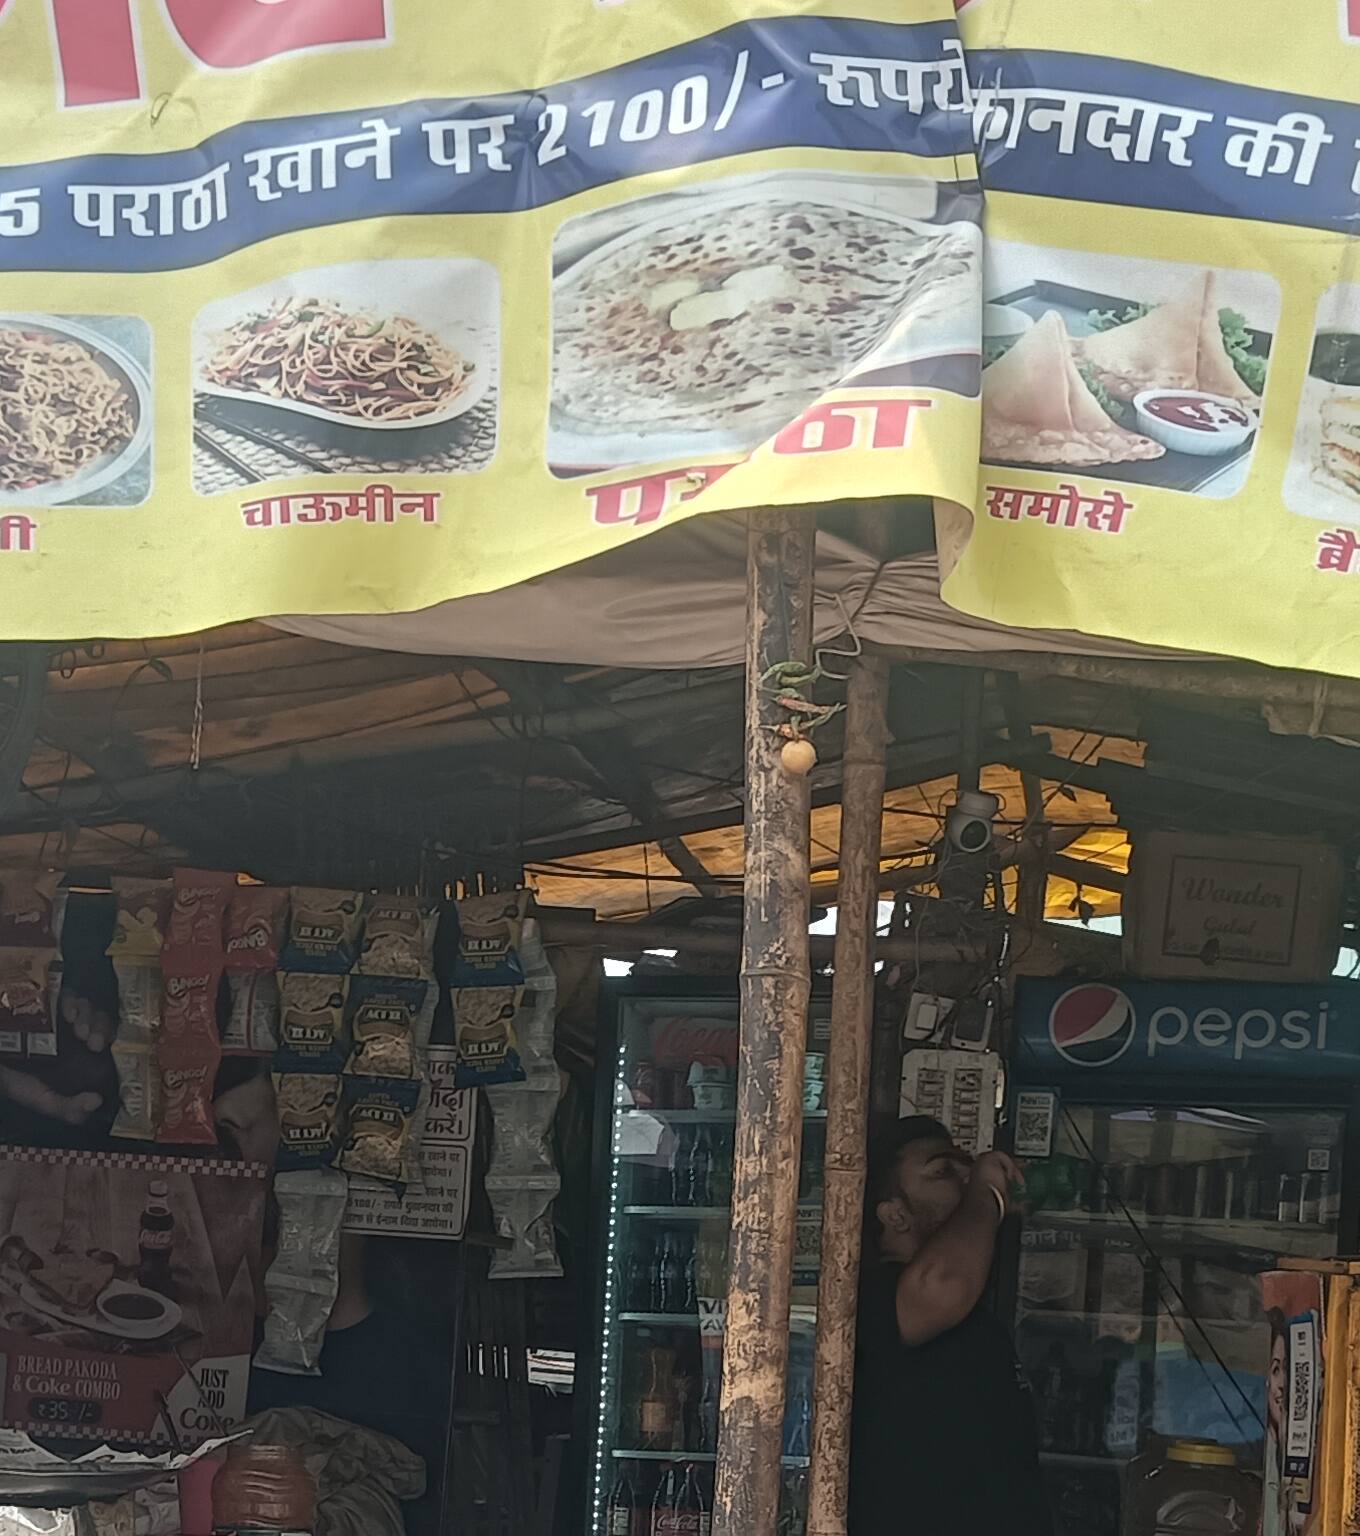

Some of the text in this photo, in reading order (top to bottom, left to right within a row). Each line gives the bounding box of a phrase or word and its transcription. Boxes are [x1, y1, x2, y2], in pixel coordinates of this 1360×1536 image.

[68, 163, 230, 238] पराठा
[244, 120, 400, 203] खाने
[423, 116, 513, 176] पर
[535, 50, 786, 167] 2100/-
[968, 88, 1213, 168] कानदार
[1223, 111, 1334, 184] की
[240, 485, 441, 528] चाऊमीन
[986, 484, 1134, 533] समोसे
[1147, 1001, 1329, 1061] pepsi
[12, 1375, 121, 1400] & Coke COMBO
[17, 1353, 118, 1380] BREAD PAKODA
[199, 1367, 229, 1390] JUST
[179, 1406, 235, 1433] Coke
